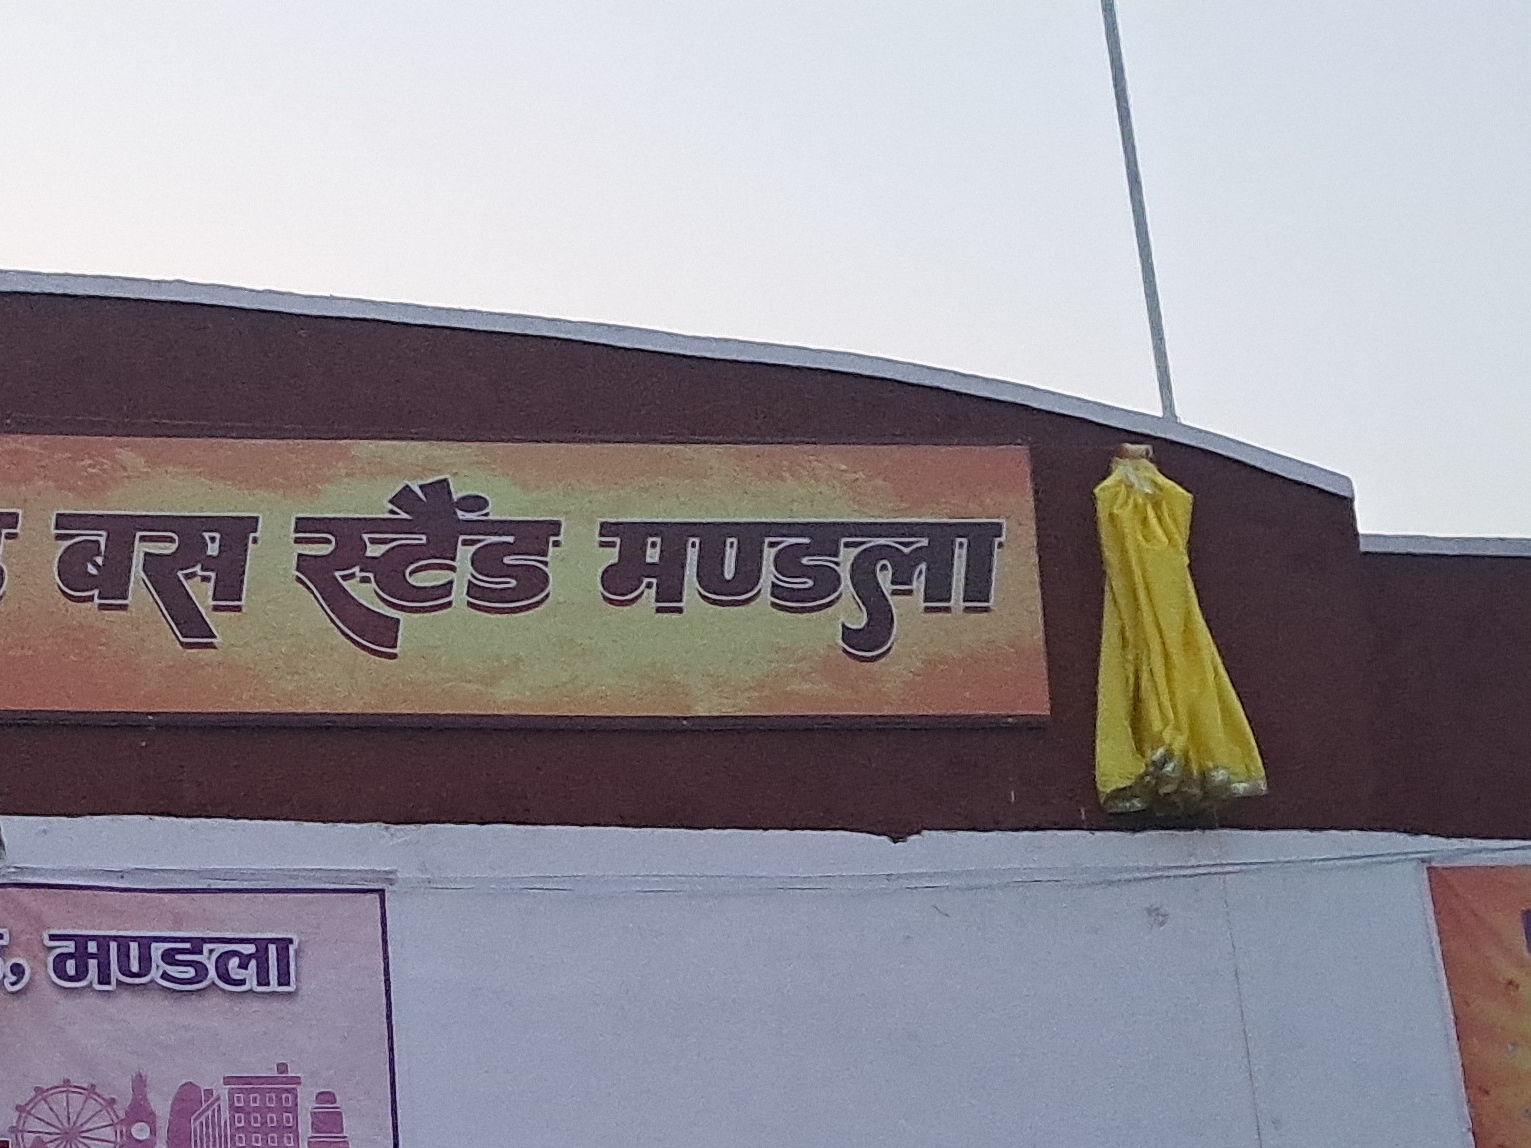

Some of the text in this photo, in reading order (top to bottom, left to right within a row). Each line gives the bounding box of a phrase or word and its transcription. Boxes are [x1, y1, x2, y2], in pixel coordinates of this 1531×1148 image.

[53, 510, 260, 649] बस
[293, 475, 563, 660] स्टैंड
[597, 518, 1006, 663] मण्डला
[43, 933, 297, 990] मण्डला
